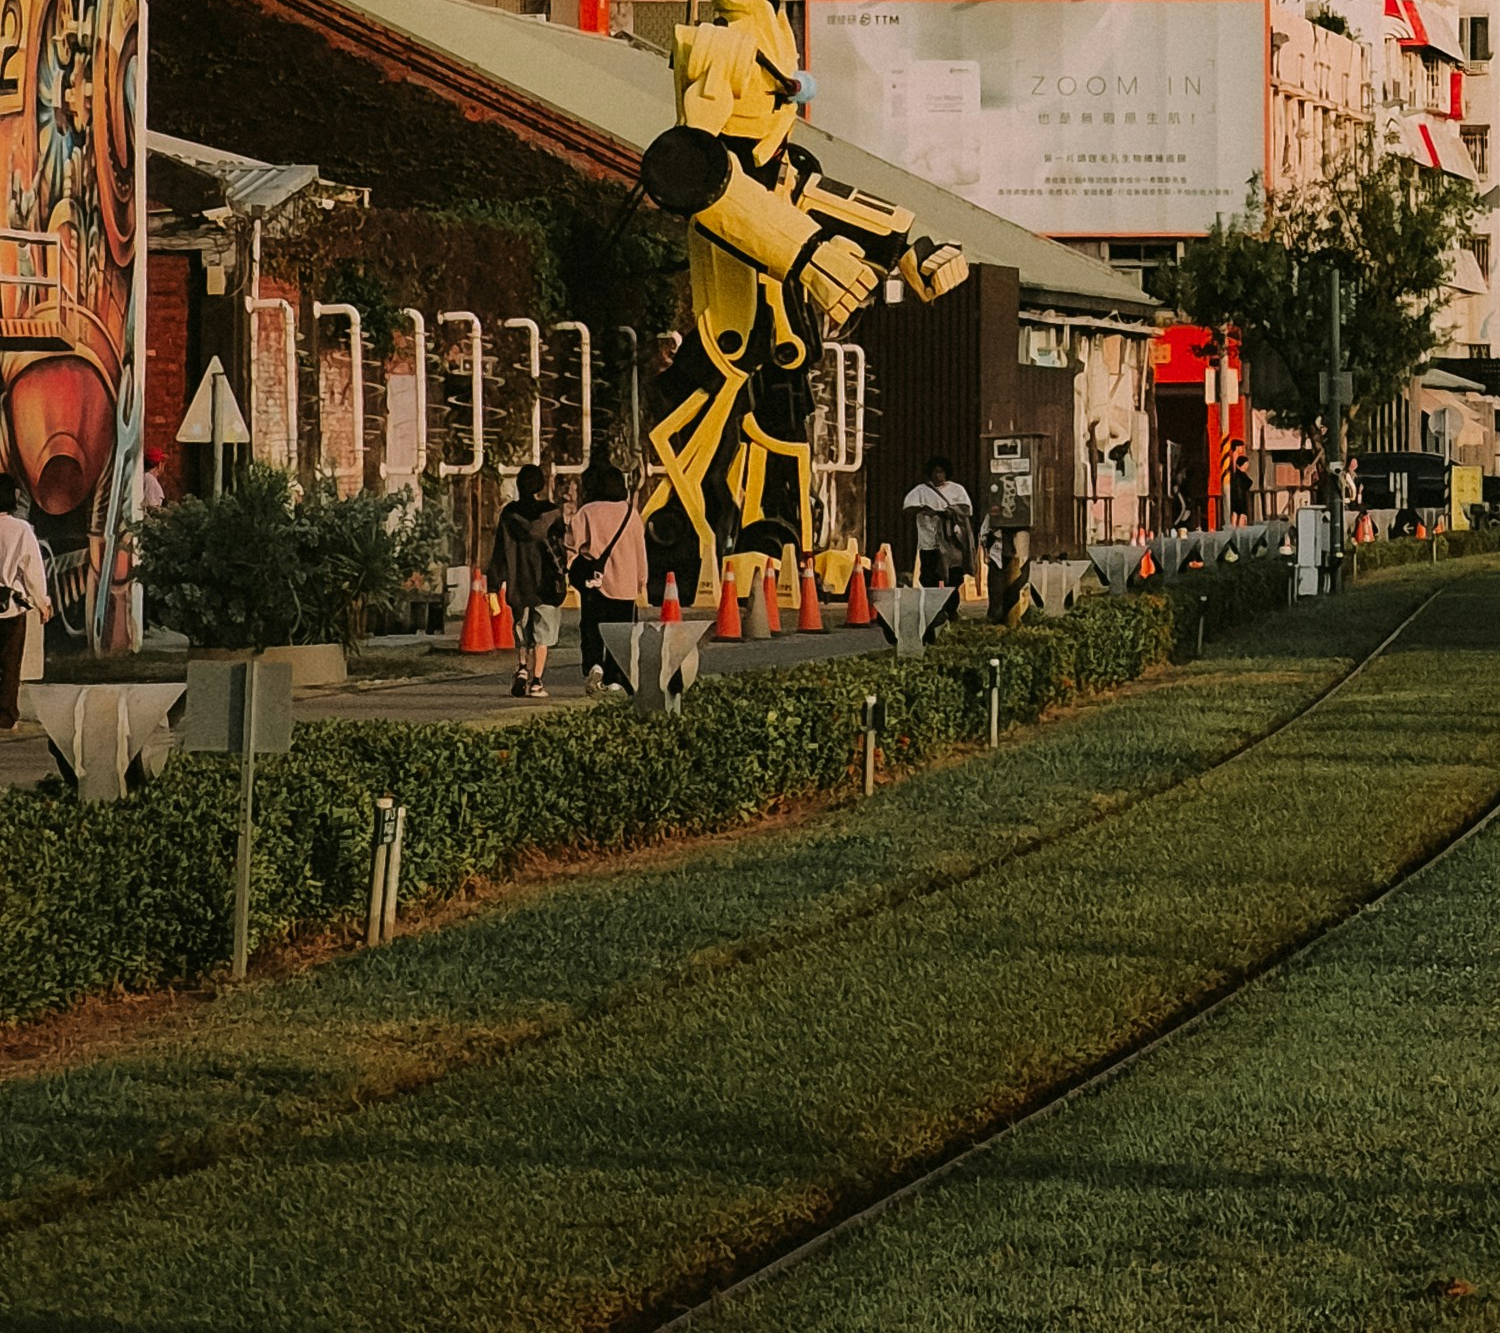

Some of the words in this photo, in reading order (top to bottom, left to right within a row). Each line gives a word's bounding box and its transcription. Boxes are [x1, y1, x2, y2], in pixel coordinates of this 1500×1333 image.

[875, 15, 900, 25] TTM
[1031, 76, 1138, 96] ZOOM
[1168, 76, 1201, 95] IN
